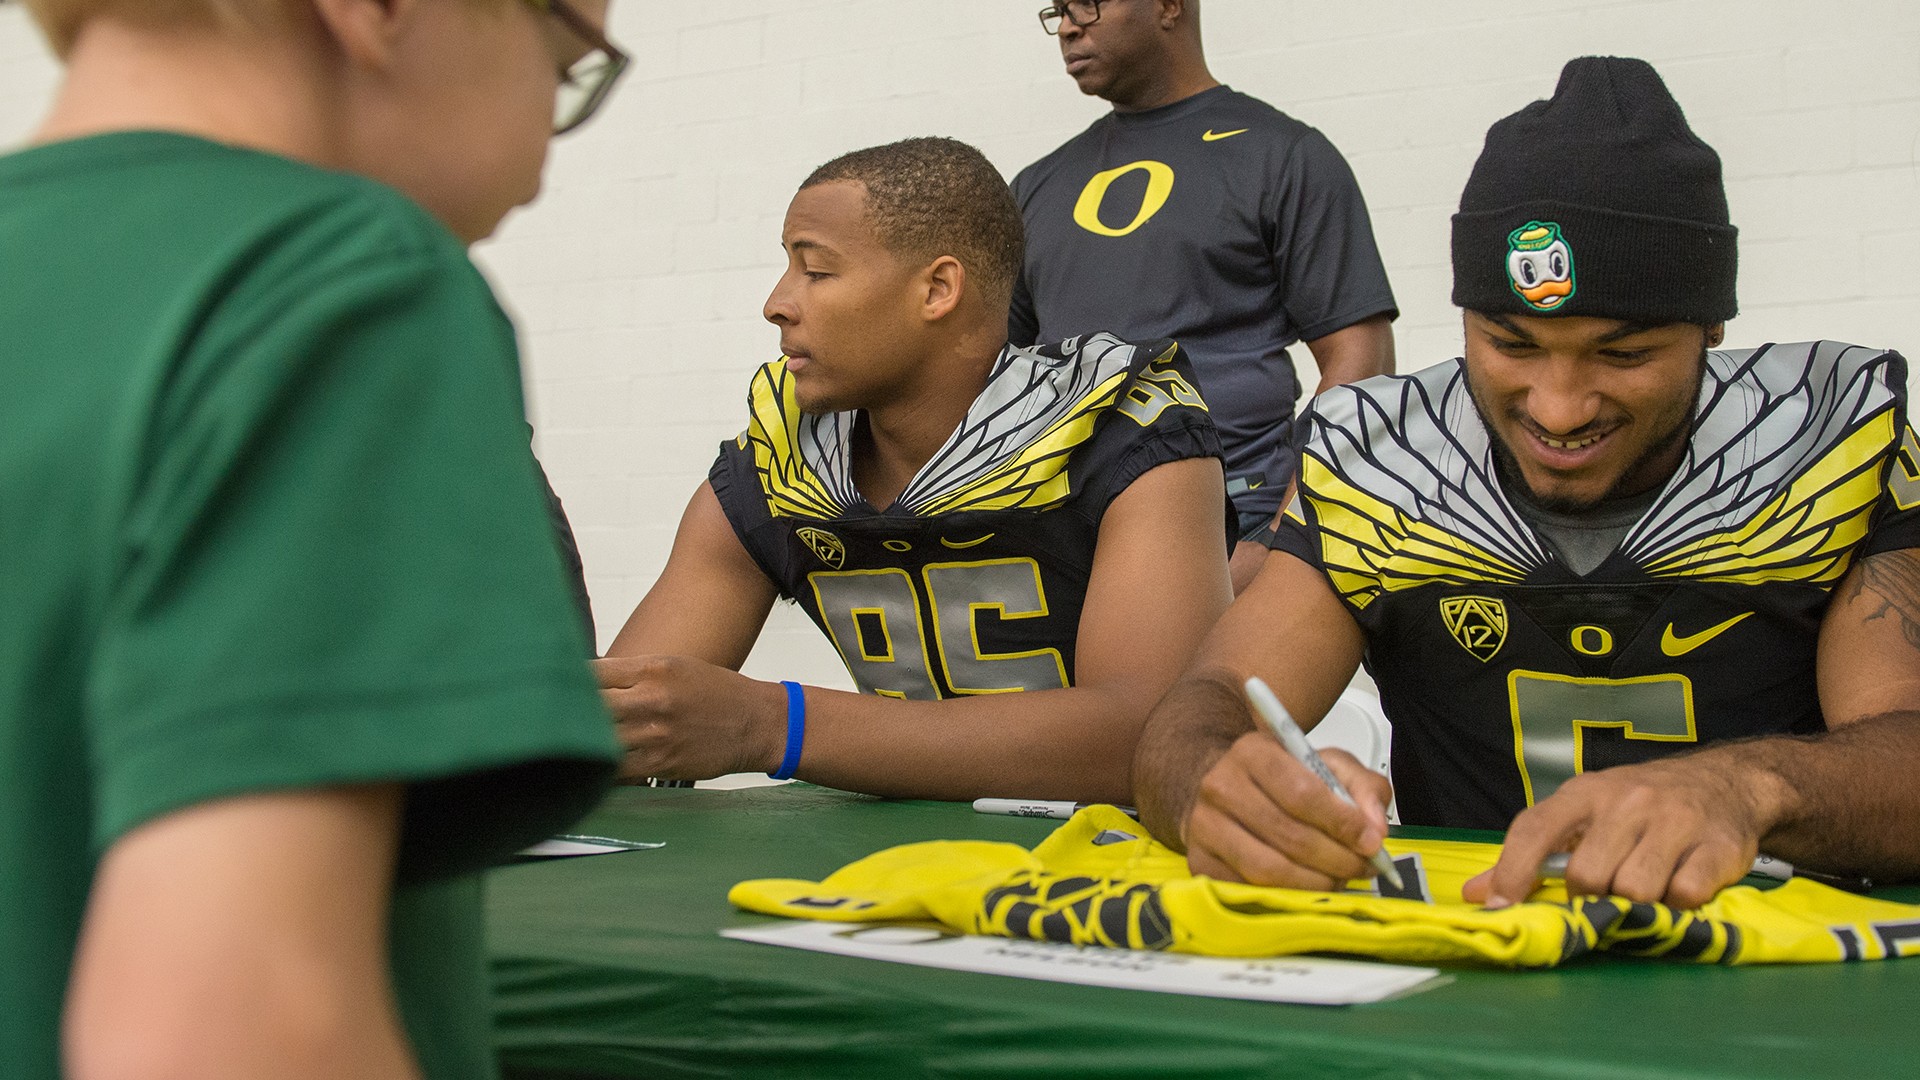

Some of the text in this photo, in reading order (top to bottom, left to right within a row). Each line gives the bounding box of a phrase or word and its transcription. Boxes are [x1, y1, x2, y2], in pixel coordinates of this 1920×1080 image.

[1073, 160, 1175, 237] O
[816, 545, 841, 561] 12
[1443, 599, 1504, 638] PAC
[1462, 625, 1497, 649] 12
[1571, 625, 1613, 656] O
